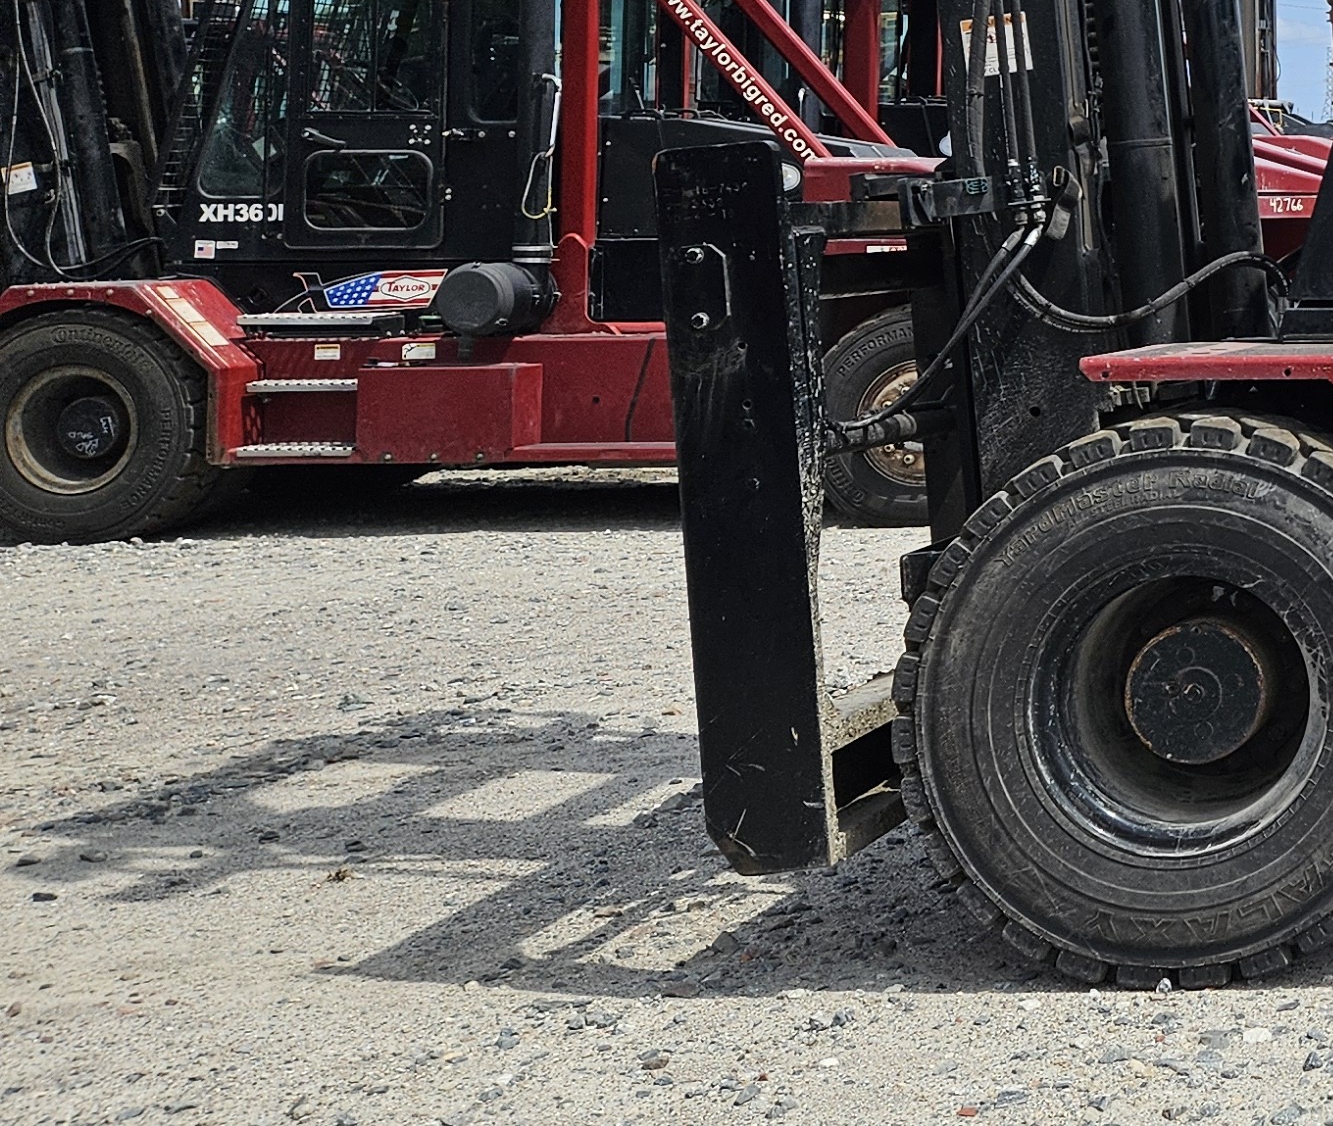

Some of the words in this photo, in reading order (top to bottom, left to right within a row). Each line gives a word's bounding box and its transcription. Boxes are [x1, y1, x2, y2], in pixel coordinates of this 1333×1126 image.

[1269, 197, 1304, 213] 42766
[387, 282, 425, 292] TAYLOR
[1168, 469, 1262, 502] Radial
